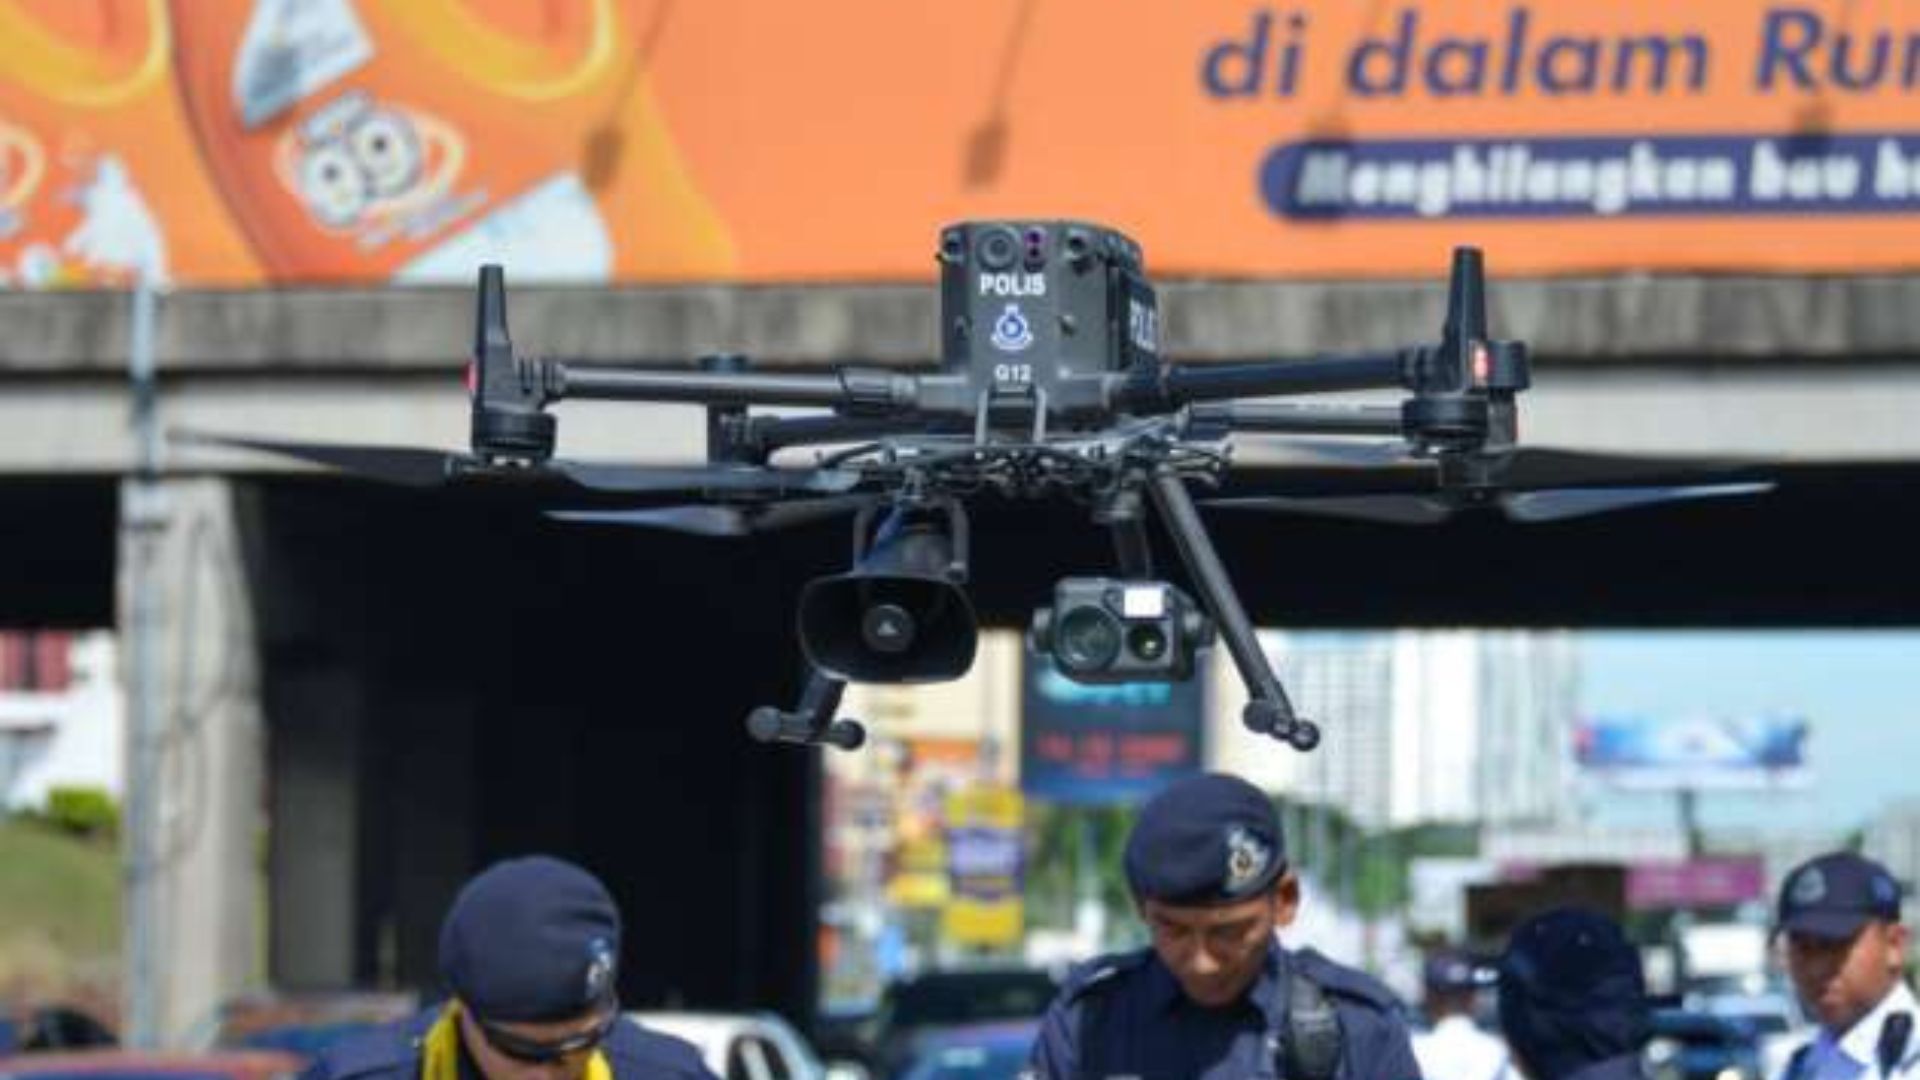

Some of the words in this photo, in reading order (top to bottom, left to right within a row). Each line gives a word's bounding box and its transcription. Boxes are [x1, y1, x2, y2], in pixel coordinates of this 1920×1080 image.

[1202, 11, 1306, 96] di
[1345, 8, 1708, 96] dalam
[980, 272, 1046, 295] POLIS
